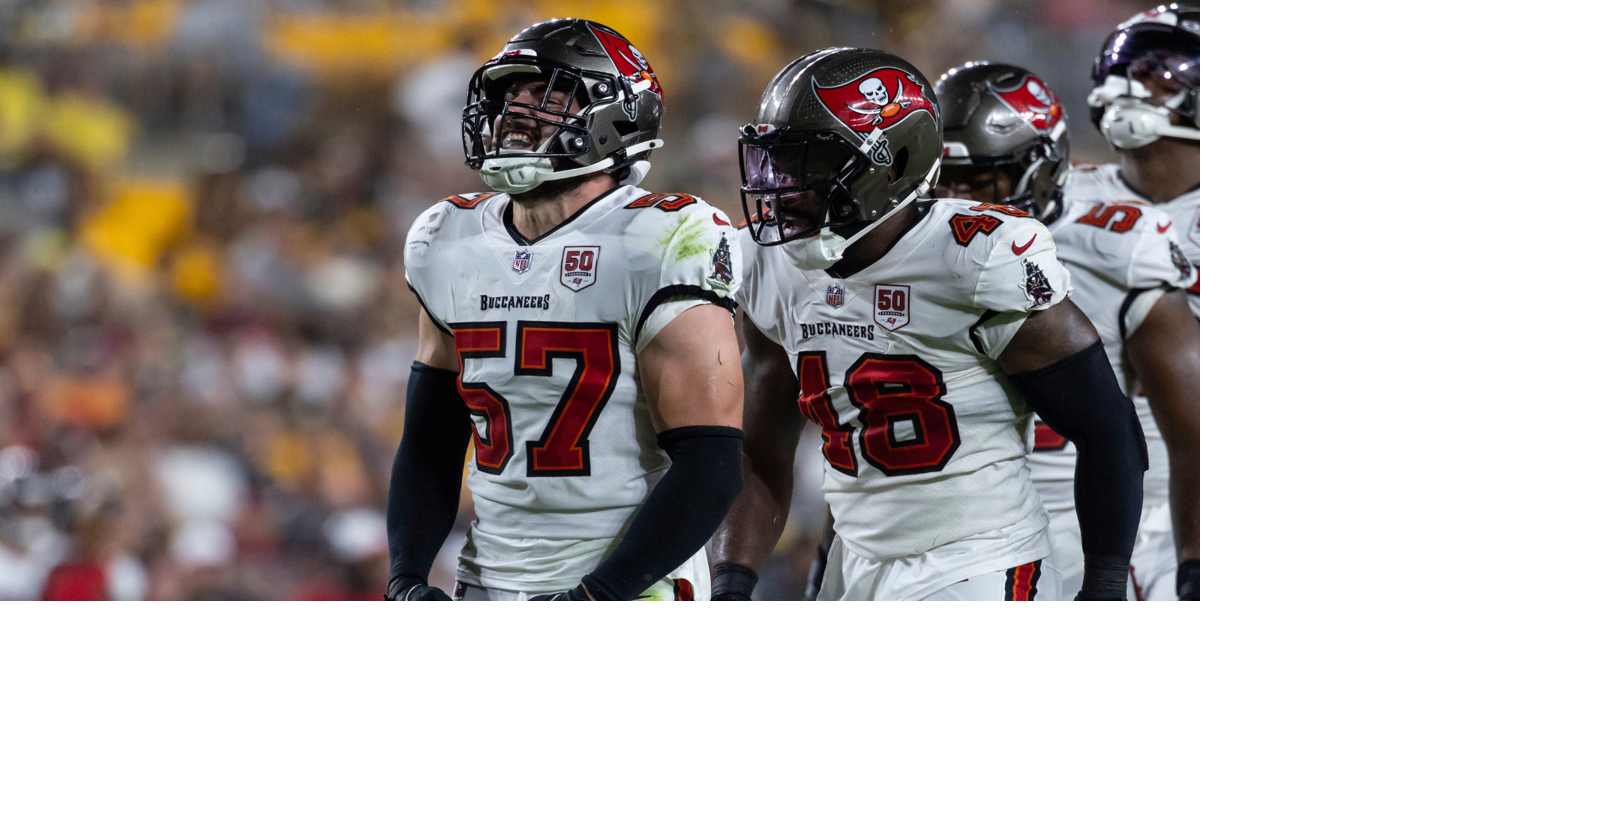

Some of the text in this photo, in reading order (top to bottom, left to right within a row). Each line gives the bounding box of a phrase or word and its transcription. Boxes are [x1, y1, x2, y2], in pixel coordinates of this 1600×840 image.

[623, 193, 698, 213] 5
[1075, 201, 1146, 234] 5
[565, 250, 595, 272] 50
[480, 294, 551, 313] BUCCANEERS
[828, 294, 842, 305] NFL
[877, 288, 906, 312] 50
[800, 322, 875, 341] BUCCANEERS
[447, 320, 621, 477] 57
[797, 350, 961, 478] 48
